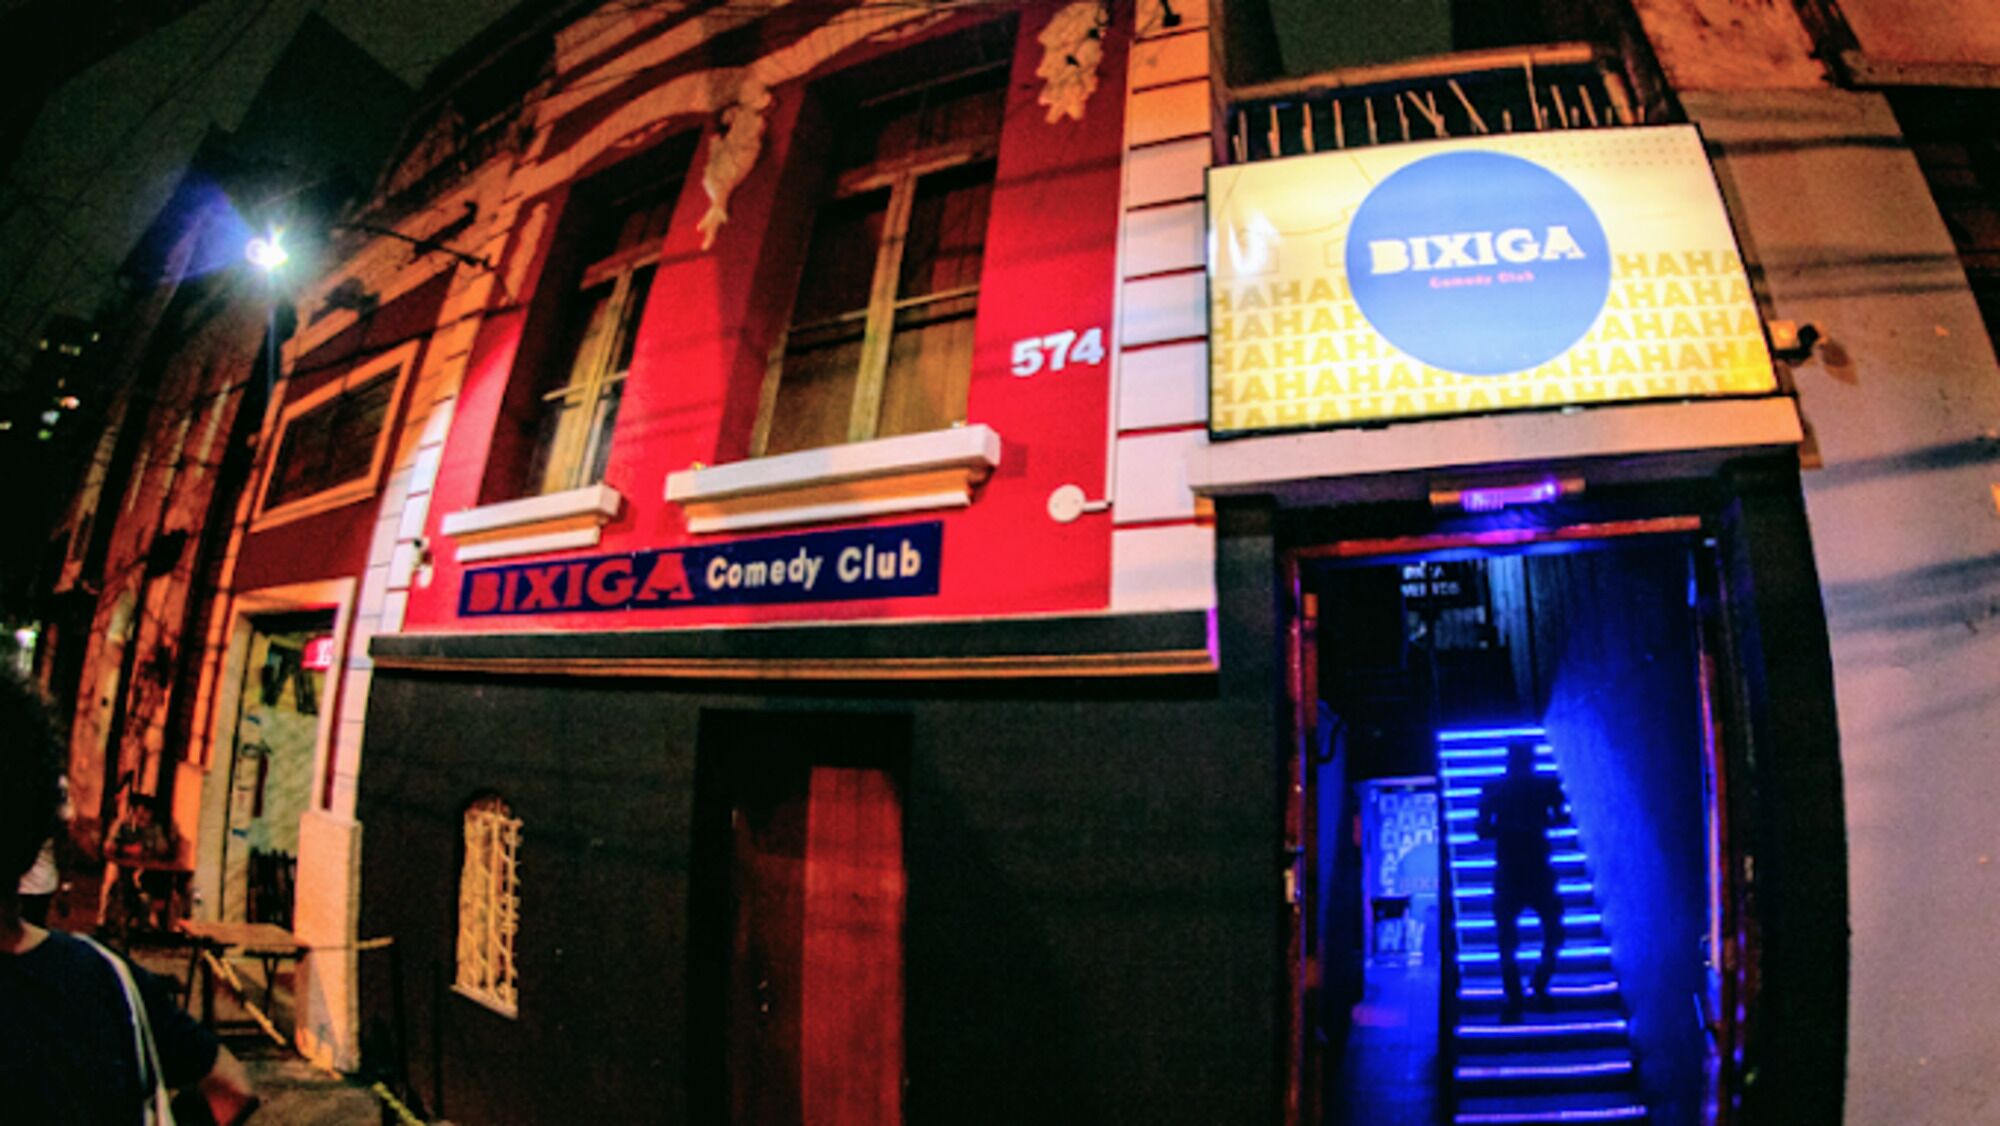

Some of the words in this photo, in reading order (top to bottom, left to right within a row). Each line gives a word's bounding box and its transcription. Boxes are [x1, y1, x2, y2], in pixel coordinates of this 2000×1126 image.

[1367, 225, 1586, 275] BIXIGA
[1429, 274, 1492, 289] Comedy
[1497, 271, 1535, 284] Club
[1011, 328, 1104, 377] 574
[467, 552, 695, 613] BIXIGA
[706, 547, 822, 590] Comedy
[836, 539, 921, 581] Club
